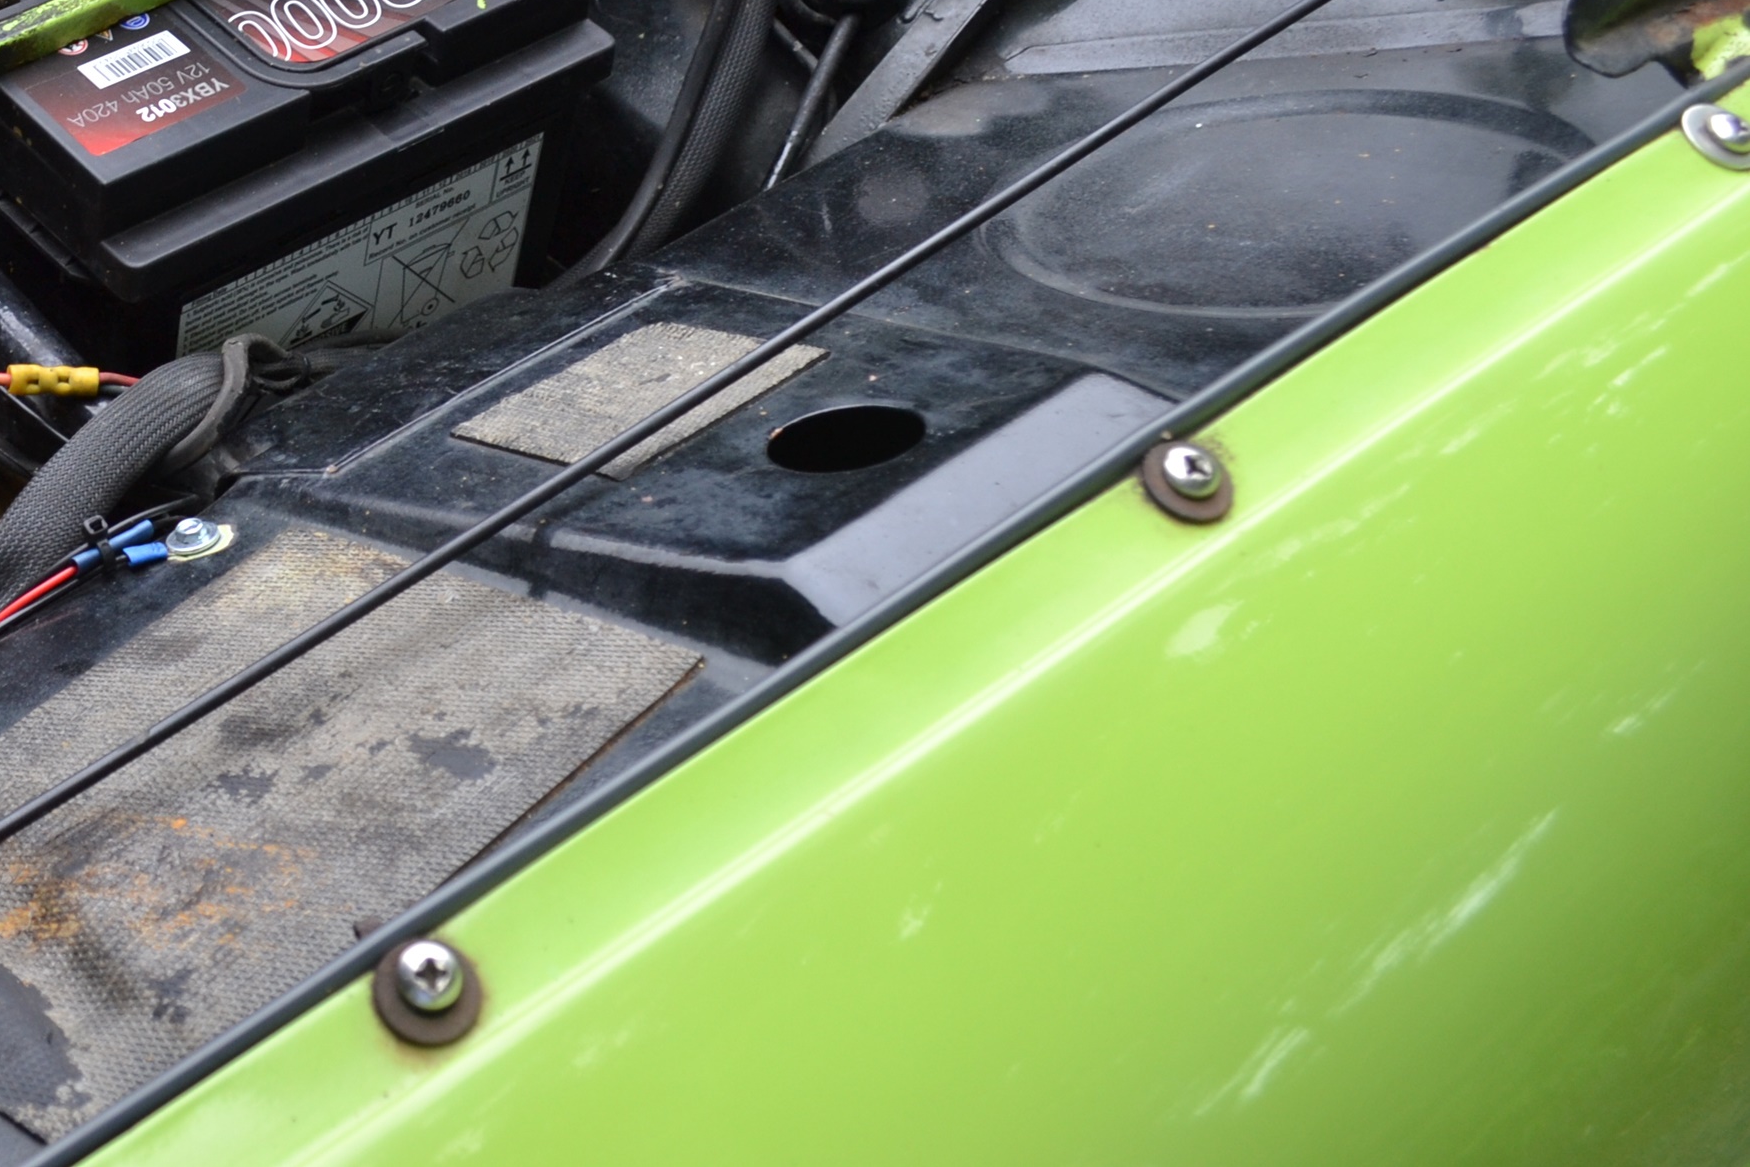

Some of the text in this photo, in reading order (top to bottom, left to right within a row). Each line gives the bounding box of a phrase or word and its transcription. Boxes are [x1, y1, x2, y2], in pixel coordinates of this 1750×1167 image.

[66, 61, 211, 128] 12V 50Ah 420A
[135, 77, 230, 123] YBX3012
[372, 221, 397, 247] YT
